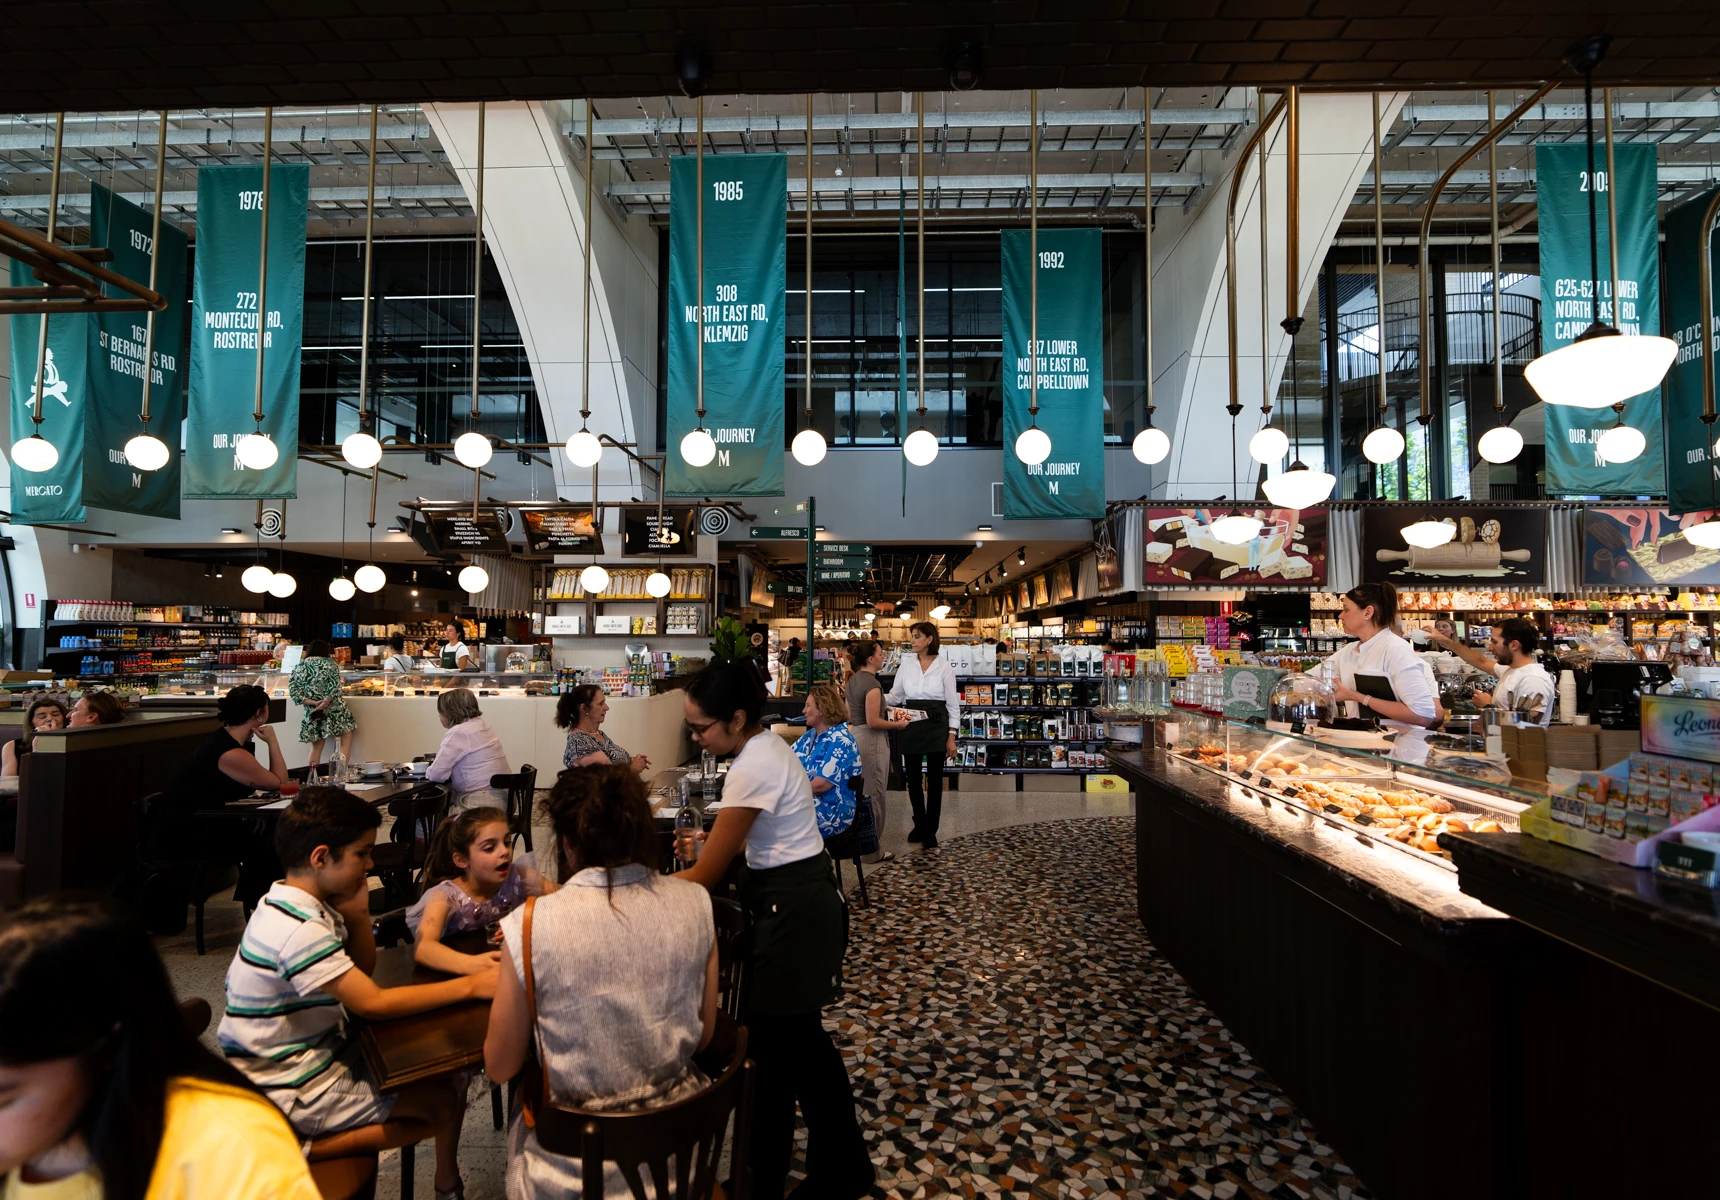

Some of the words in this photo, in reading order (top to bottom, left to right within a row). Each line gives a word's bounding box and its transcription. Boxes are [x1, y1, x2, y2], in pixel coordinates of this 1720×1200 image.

[713, 181, 743, 201] 1985
[130, 229, 152, 256] 1972
[1039, 252, 1064, 268] 1992
[236, 292, 257, 309] 272
[716, 285, 737, 302] 308
[723, 305, 748, 322] EAST
[751, 304, 768, 323] RD,
[1556, 300, 1591, 318] NORTH
[1622, 302, 1640, 321] RD,
[205, 312, 259, 329] MONTECUT
[267, 311, 283, 329] RD,
[131, 324, 146, 343] 167
[704, 324, 748, 343] KLEMZIG
[100, 330, 108, 348] ST
[112, 336, 158, 367] BERNARS
[161, 354, 177, 373] RD,
[1047, 340, 1078, 355] LOWER
[110, 354, 164, 385] ROSTREOR
[1050, 358, 1071, 372] EAST
[1074, 357, 1089, 373] RD,
[213, 434, 228, 448] OUR
[714, 428, 755, 443] JOURNEY
[1568, 429, 1586, 443] OUR
[109, 449, 126, 465] OUR
[718, 450, 730, 467] M
[1687, 442, 1705, 464] OUR
[1028, 463, 1042, 475] OUR
[1045, 462, 1080, 475] JOURNEY
[132, 473, 142, 488] M
[1049, 481, 1059, 495] M
[25, 485, 63, 496] MERCATO
